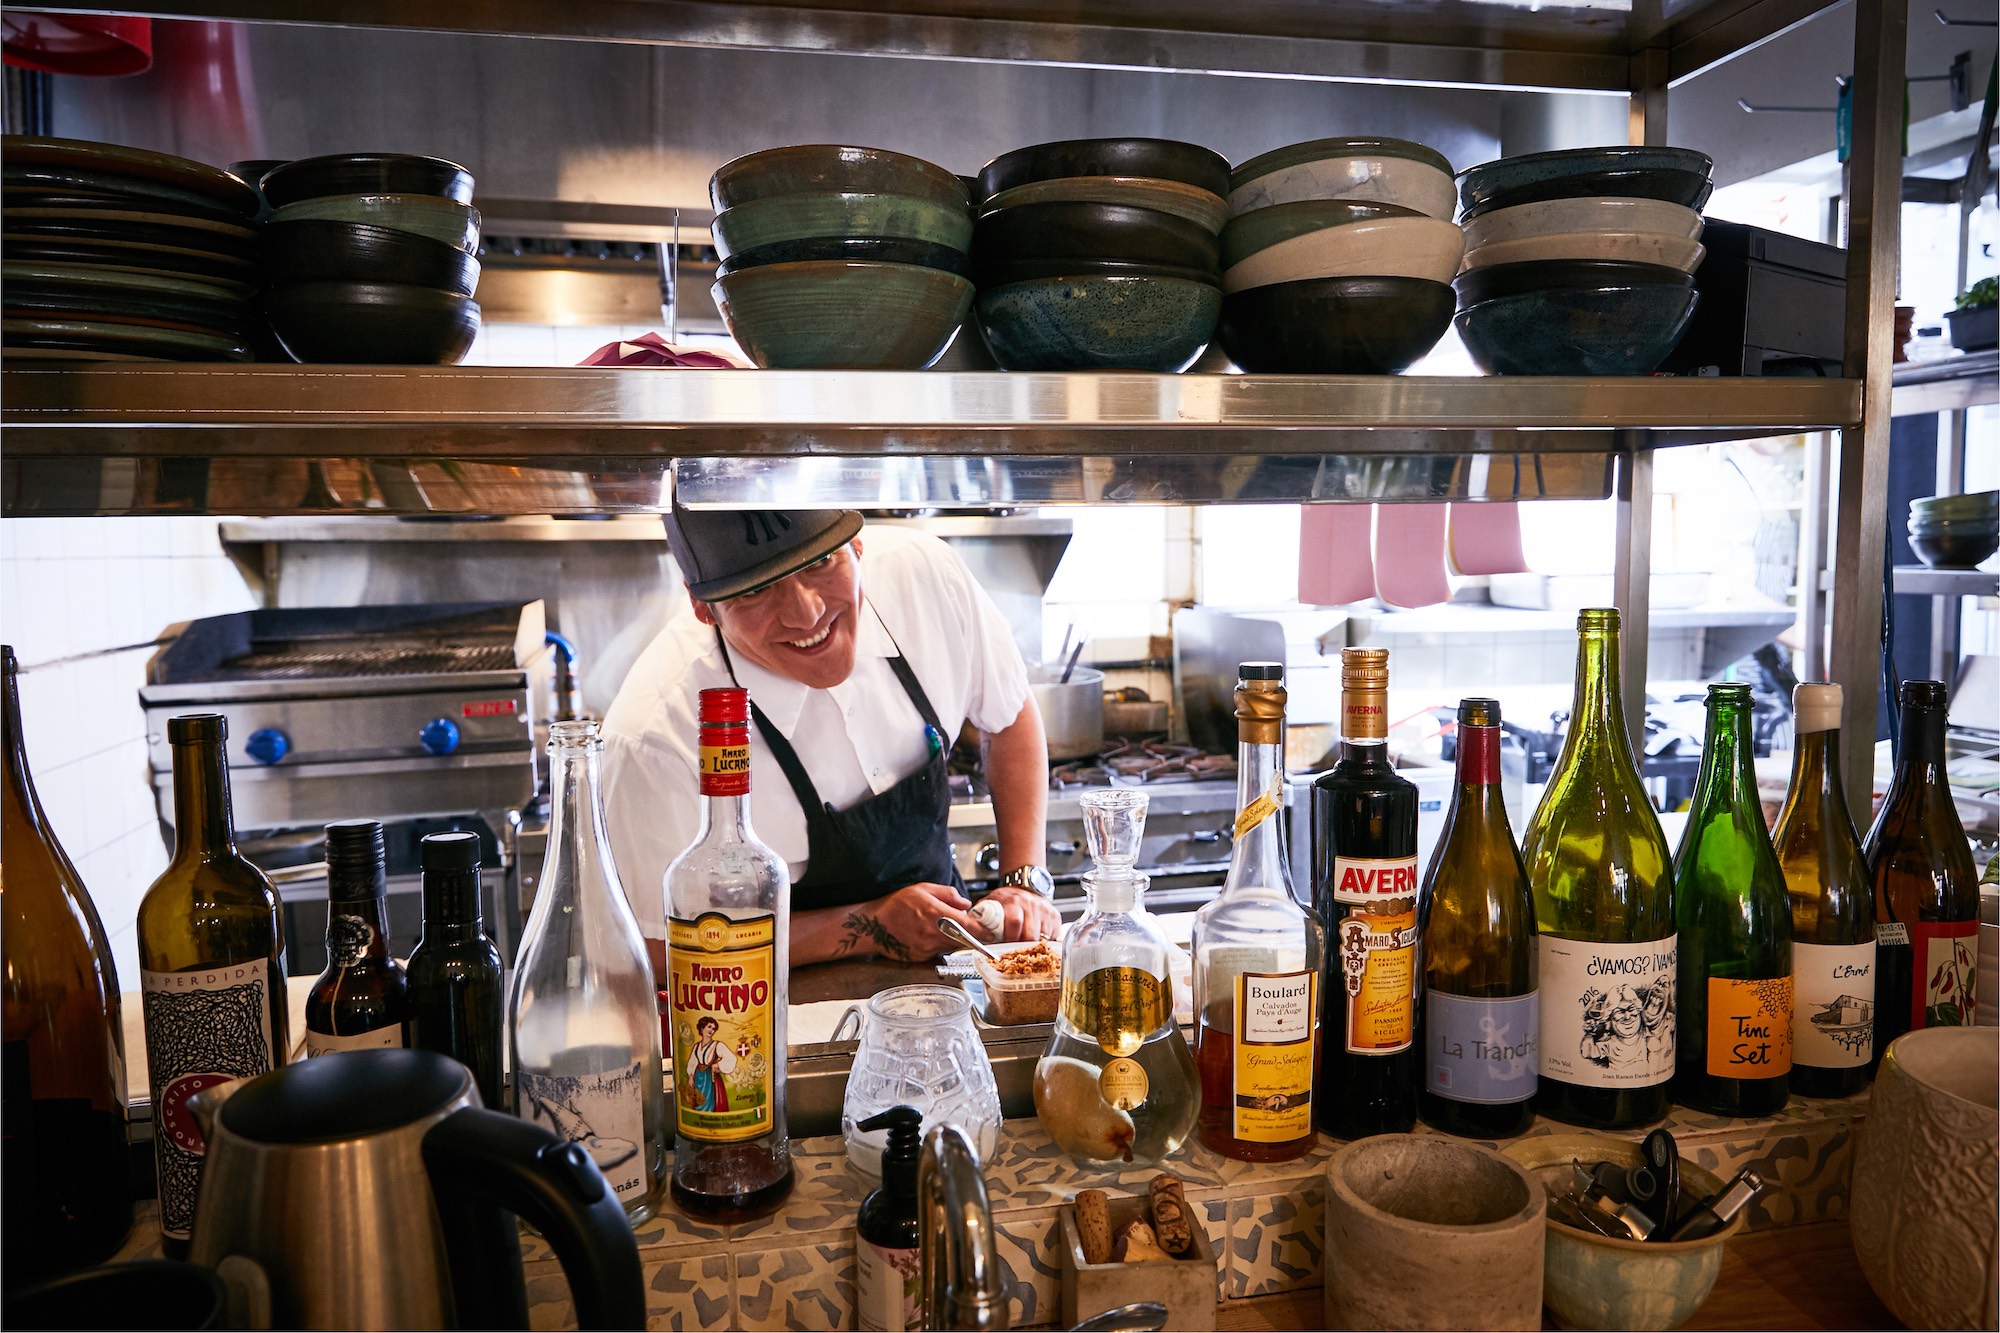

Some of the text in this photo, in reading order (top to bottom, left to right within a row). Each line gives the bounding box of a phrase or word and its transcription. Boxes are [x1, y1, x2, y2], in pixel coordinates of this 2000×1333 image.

[1346, 705, 1383, 715] AVERNA
[721, 748, 747, 759] AMARO
[713, 756, 750, 772] LUCANO
[706, 931, 720, 940] 1894
[736, 930, 762, 940] LUCANIA
[1345, 925, 1389, 954] AMARO
[691, 962, 744, 984] AMARO
[1586, 955, 1651, 976] ¿VAMOS?
[164, 964, 261, 988] PERDIDA
[1104, 969, 1158, 993] Massenez
[672, 970, 769, 1014] LUCANO
[1251, 983, 1306, 999] Boulard
[1578, 986, 1601, 1007] 2016
[1256, 1007, 1302, 1017] Pays d'Auge
[1262, 1001, 1298, 1010] Calvados
[1374, 1015, 1404, 1024] PASSIONE
[1730, 1015, 1771, 1039] Tinc
[1373, 1028, 1404, 1036] SICILIA
[1441, 1035, 1463, 1060] La
[1728, 1042, 1772, 1065] Set
[1246, 1053, 1308, 1070] Grand Solage
[1104, 1075, 1143, 1083] SELECTIONS
